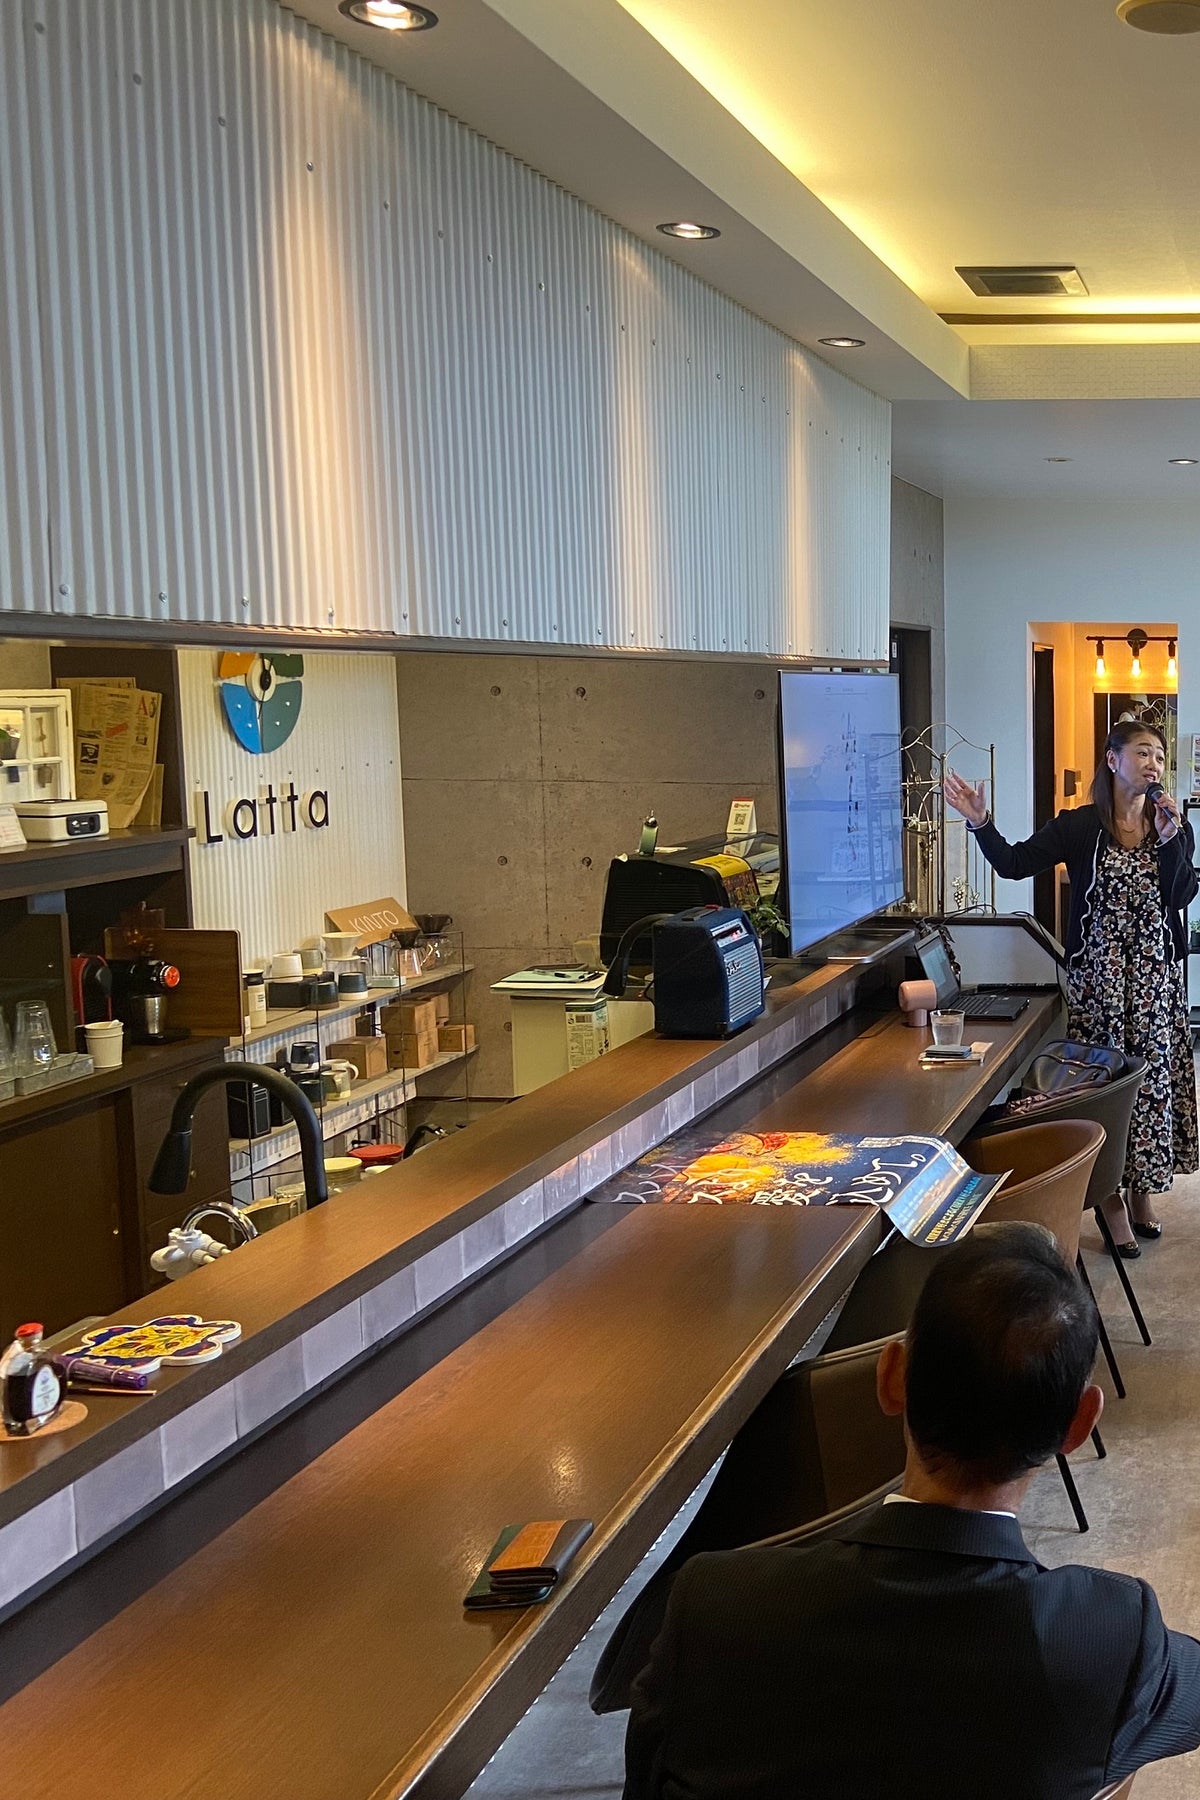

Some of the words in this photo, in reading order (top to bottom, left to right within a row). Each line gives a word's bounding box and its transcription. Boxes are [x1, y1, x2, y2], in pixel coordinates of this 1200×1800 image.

[199, 782, 329, 844] Latta
[348, 910, 399, 934] KINTO
[750, 1171, 834, 1206] 愛を
[825, 1153, 927, 1207] 込めて。
